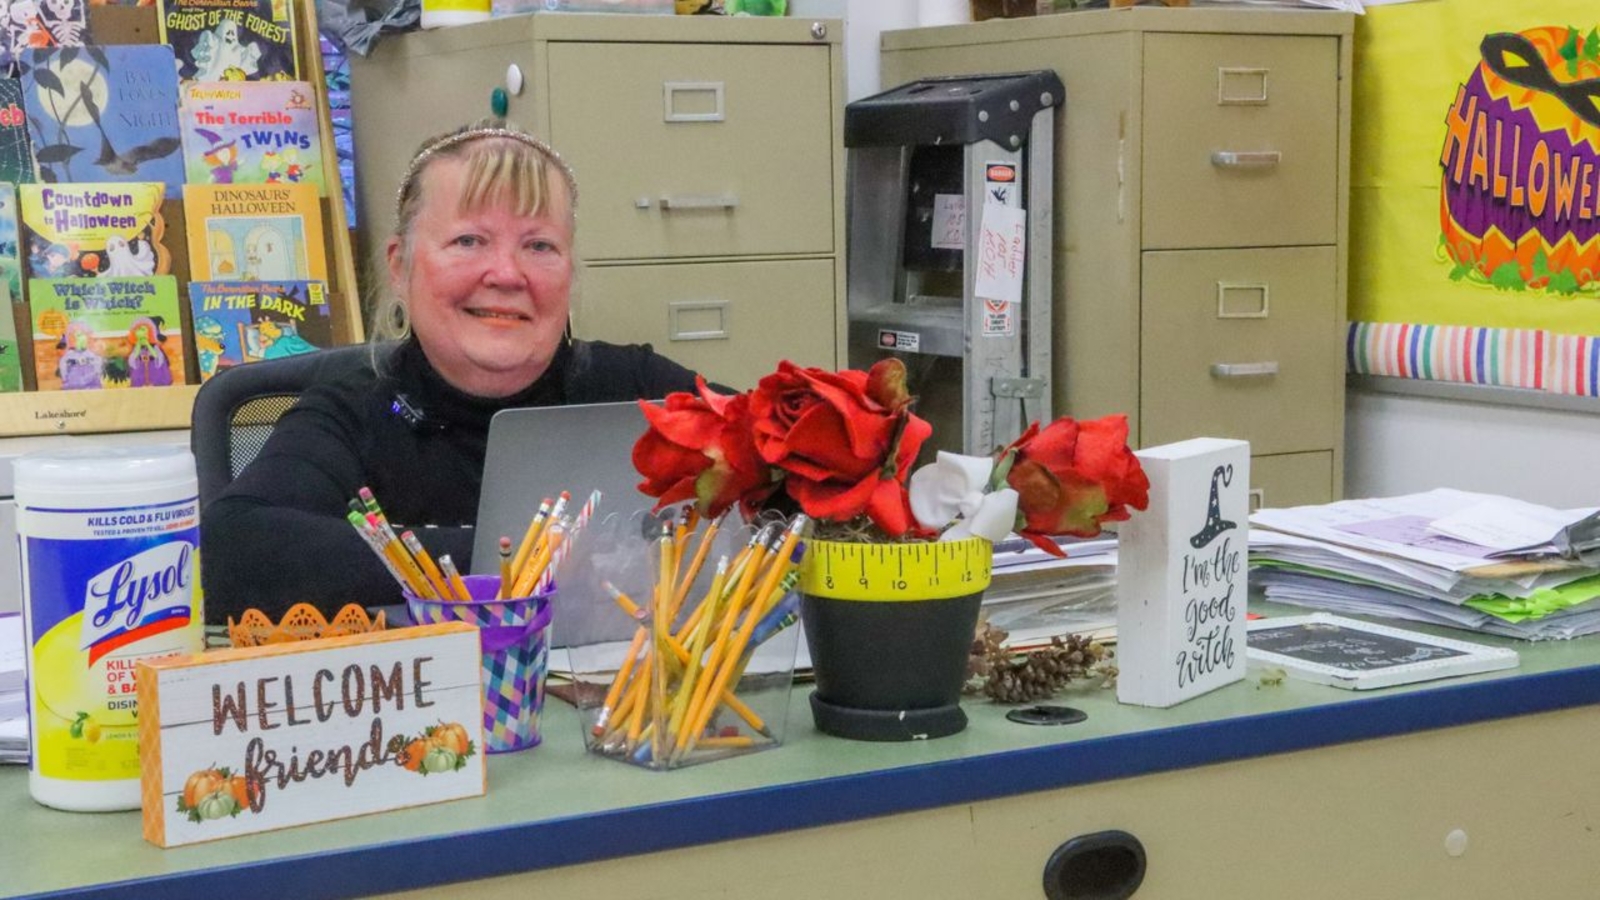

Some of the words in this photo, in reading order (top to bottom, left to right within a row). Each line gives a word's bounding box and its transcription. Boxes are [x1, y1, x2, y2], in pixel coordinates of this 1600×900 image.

[167, 12, 207, 30] GHOST
[208, 10, 222, 26] OF
[223, 9, 244, 26] THE
[245, 14, 290, 44] FOREST
[195, 112, 226, 124] The
[228, 112, 293, 125] Terrible
[241, 130, 311, 149] TWINS
[1440, 83, 1600, 222] HALLOWE
[41, 188, 133, 211] Countdown
[211, 202, 296, 215] HALLOWEEN
[44, 216, 54, 226] to
[54, 209, 137, 232] Halloween
[53, 282, 106, 297] Which
[107, 281, 156, 295] Witch
[65, 297, 81, 310] is
[82, 295, 145, 310] Which?
[203, 295, 222, 311] IN
[225, 294, 256, 309] THE
[260, 294, 306, 321] DARK
[34, 409, 86, 420] Lakeshore
[88, 517, 117, 526] KILLS
[119, 514, 146, 525] COLD
[147, 513, 153, 523] &
[154, 510, 171, 522] FLU
[93, 529, 116, 537] TESTED
[1182, 554, 1210, 594] I'm
[1210, 537, 1241, 582] the
[91, 543, 190, 628] Lysol
[825, 576, 834, 590] 8
[859, 578, 869, 590] 9
[892, 580, 907, 590] 10
[929, 577, 940, 587] 11
[961, 571, 973, 583] 12
[1185, 583, 1236, 643] good
[106, 658, 138, 671] KILL
[1176, 625, 1235, 689] witch
[107, 672, 126, 683] OF
[107, 684, 117, 695] &
[211, 656, 436, 736] WELCOME
[245, 717, 412, 814] friends
